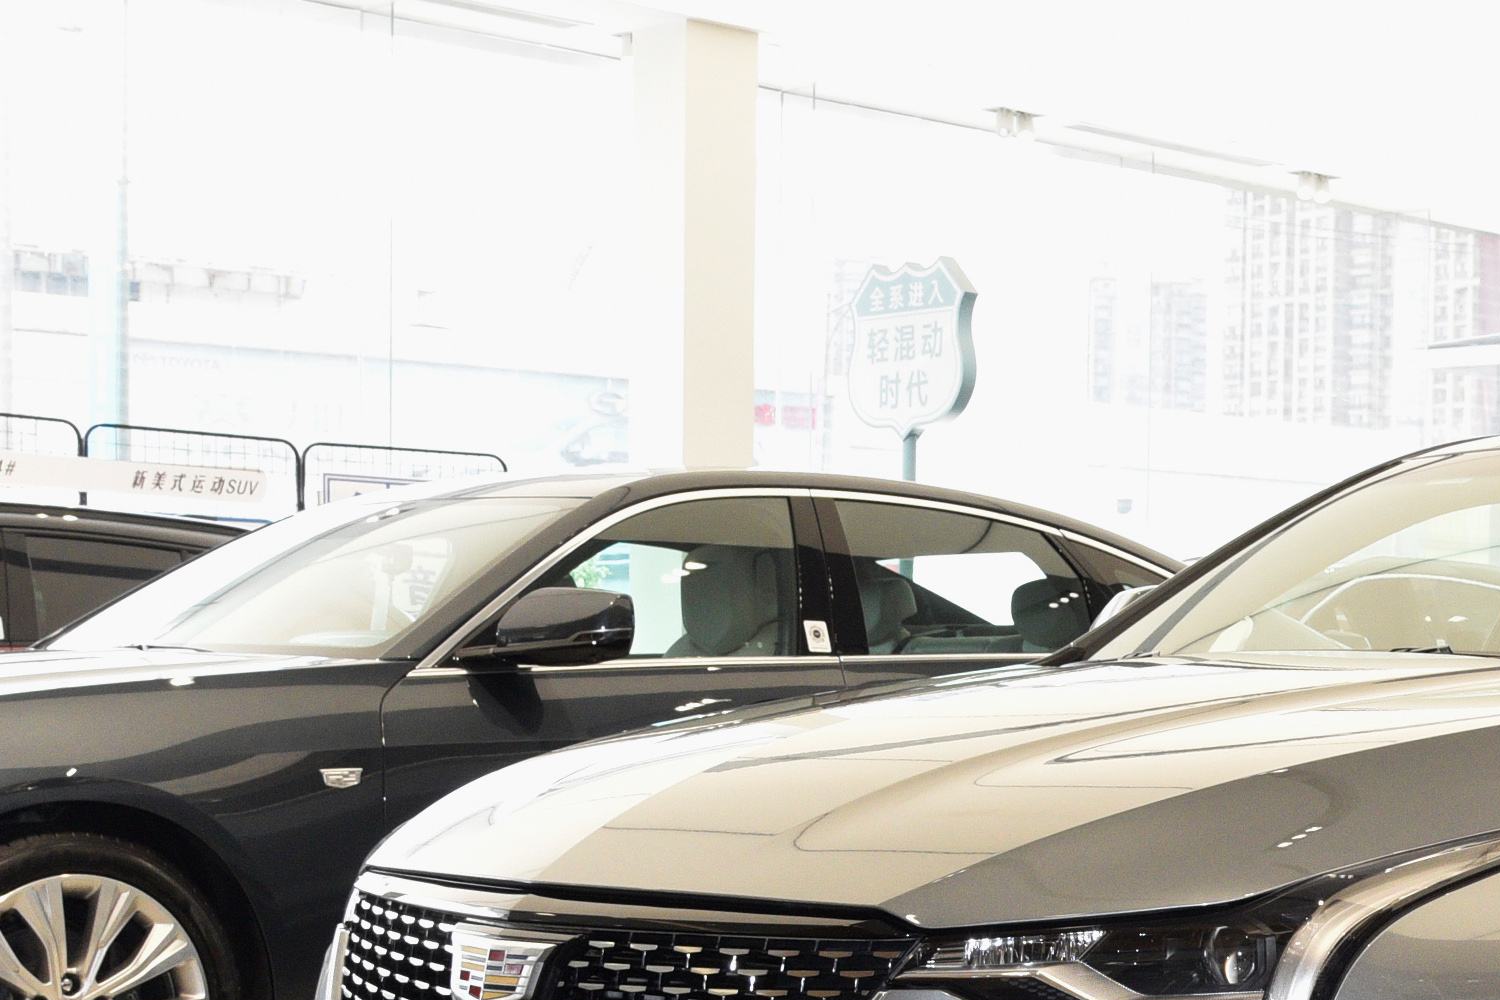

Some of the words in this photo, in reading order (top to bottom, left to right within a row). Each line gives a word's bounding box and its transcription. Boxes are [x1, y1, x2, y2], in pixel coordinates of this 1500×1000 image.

[869, 280, 943, 312] 全系进入
[867, 321, 943, 364] 轻混动
[879, 369, 929, 409] 时代
